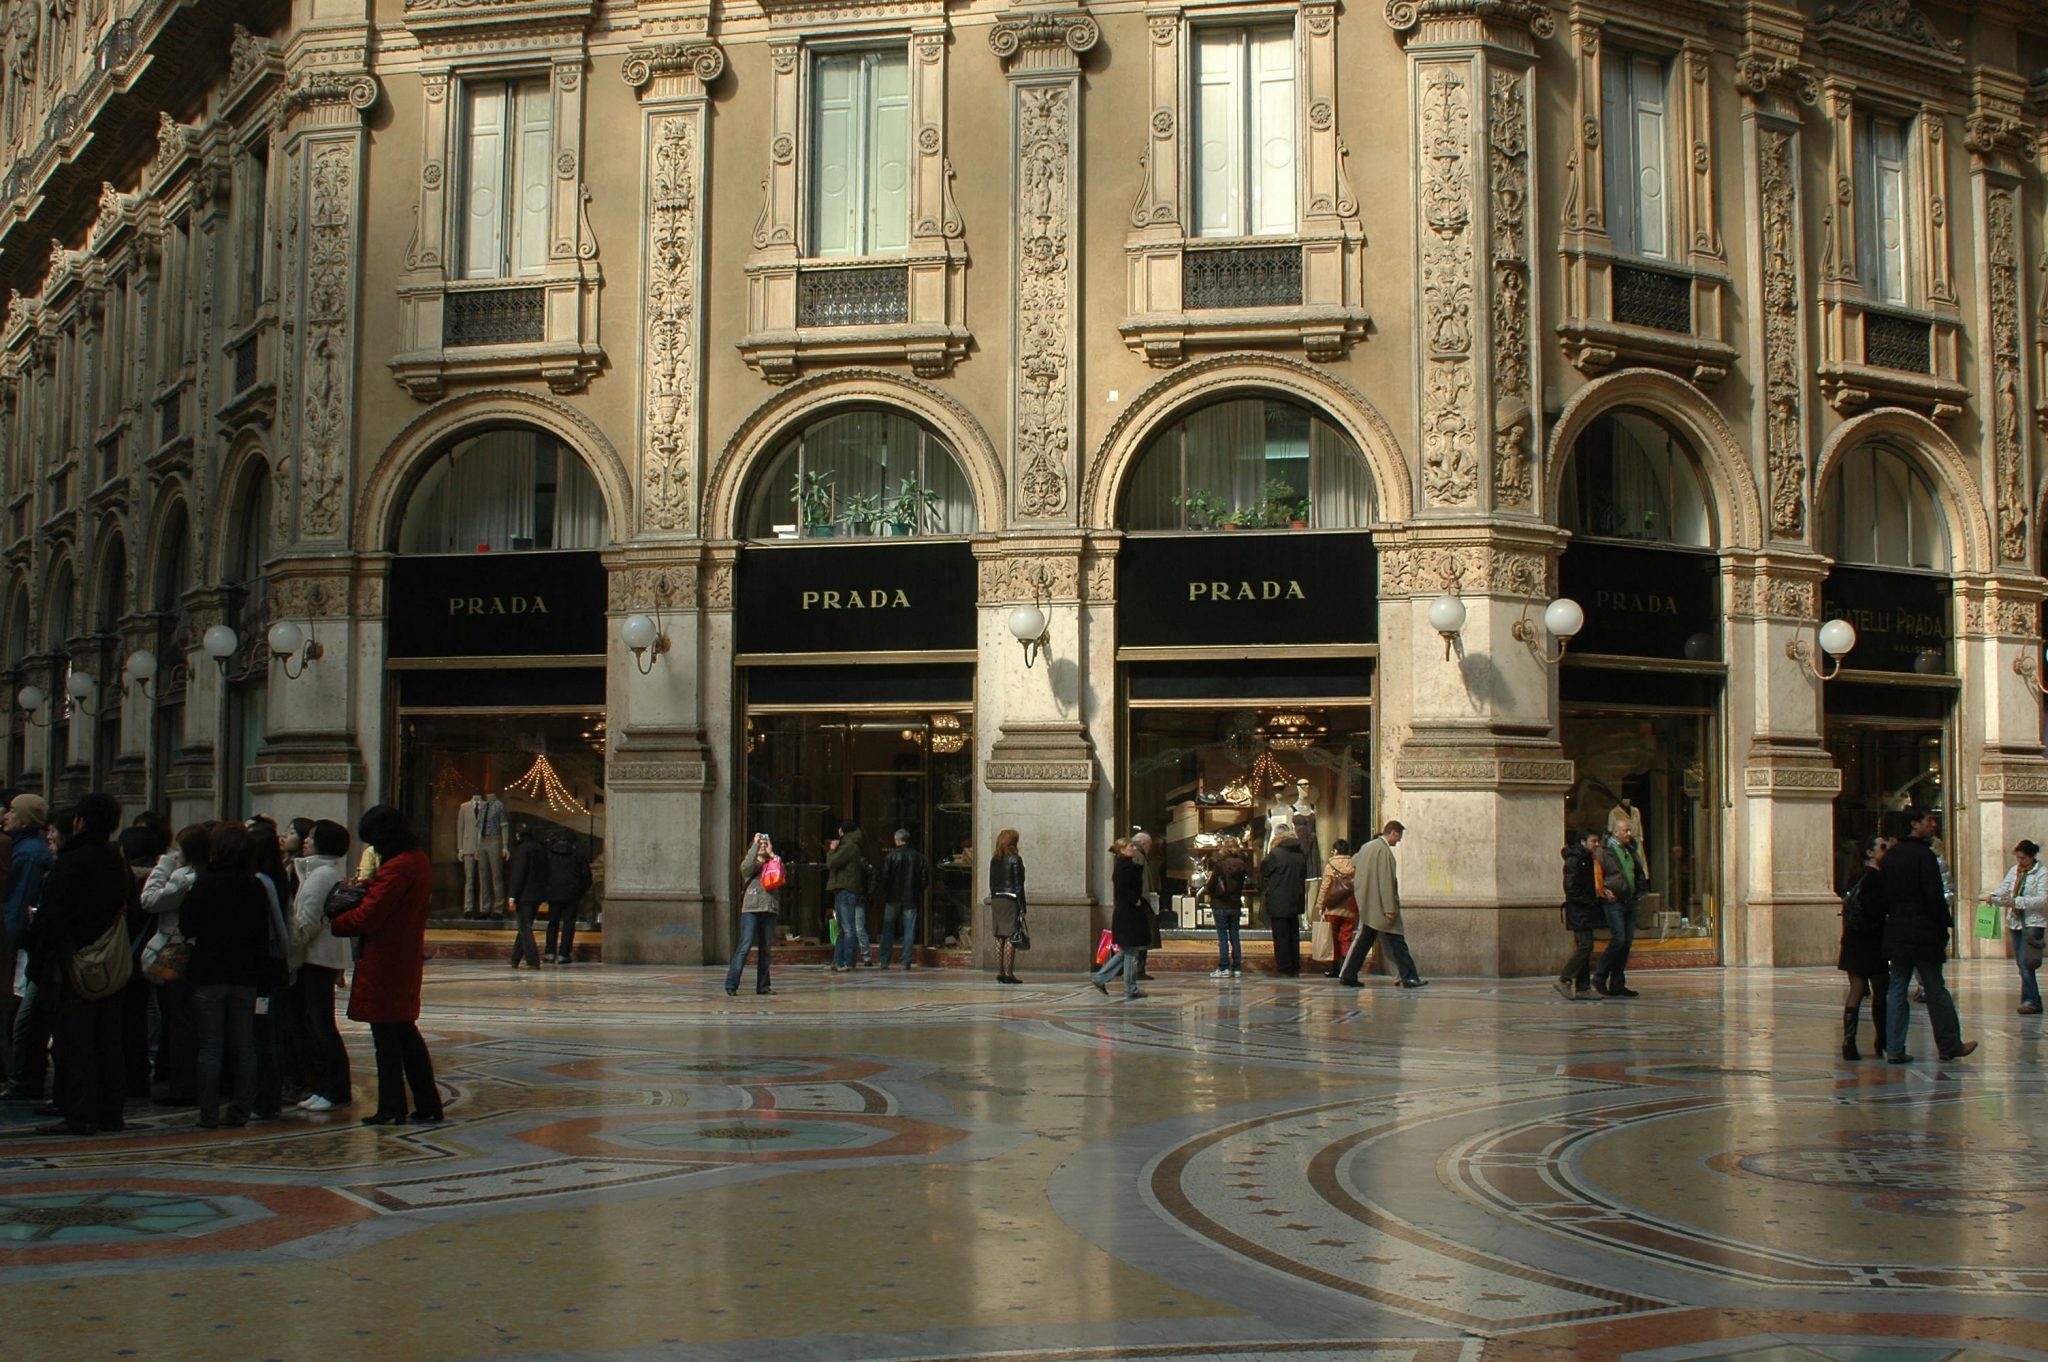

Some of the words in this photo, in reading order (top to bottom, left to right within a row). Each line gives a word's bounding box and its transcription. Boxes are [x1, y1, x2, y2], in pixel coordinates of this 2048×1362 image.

[802, 589, 911, 610] PRADA
[1189, 580, 1306, 601] PRADA
[449, 595, 549, 616] PRADA
[1597, 590, 1681, 615] PRADA
[1896, 607, 1944, 638] PRADA
